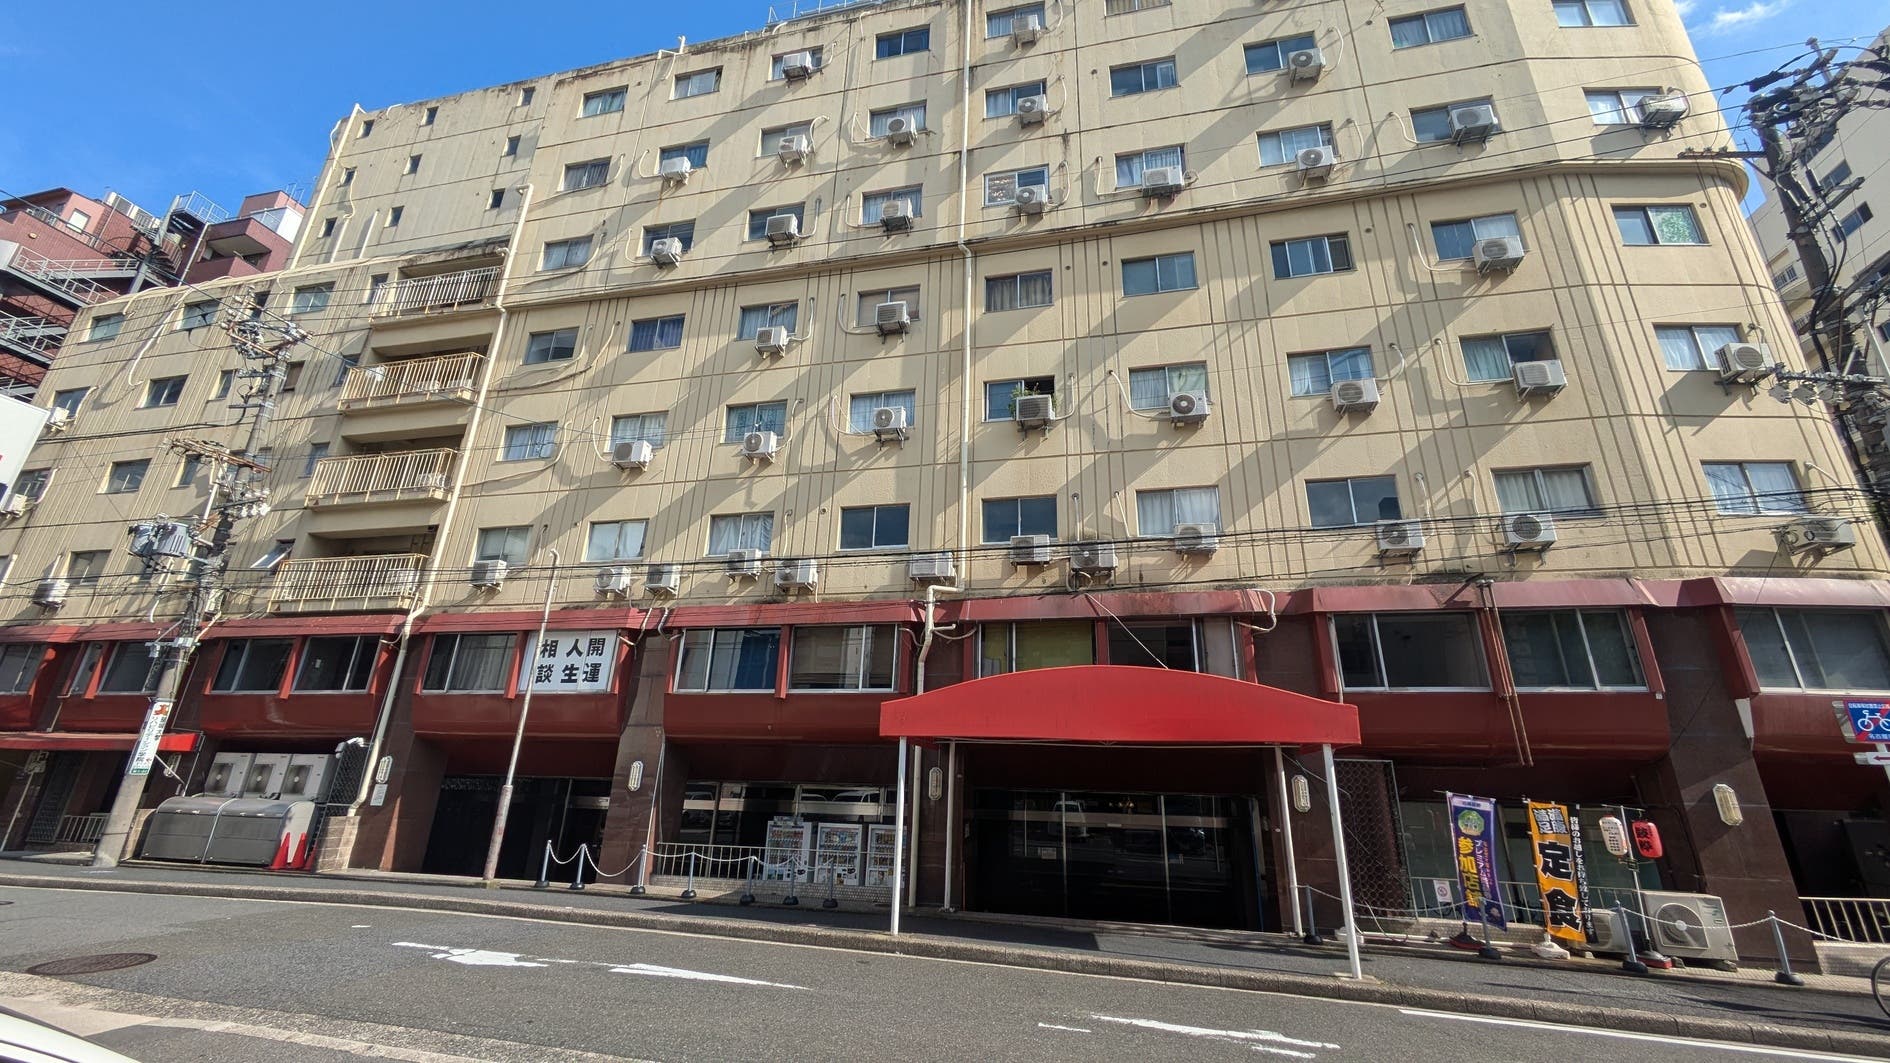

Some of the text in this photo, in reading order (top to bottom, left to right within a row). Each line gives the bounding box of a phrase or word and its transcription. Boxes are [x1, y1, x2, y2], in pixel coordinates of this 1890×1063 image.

[535, 639, 558, 683] 相談
[560, 638, 583, 683] 人生
[582, 638, 606, 682] 開運
[1538, 840, 1582, 931] 定食
